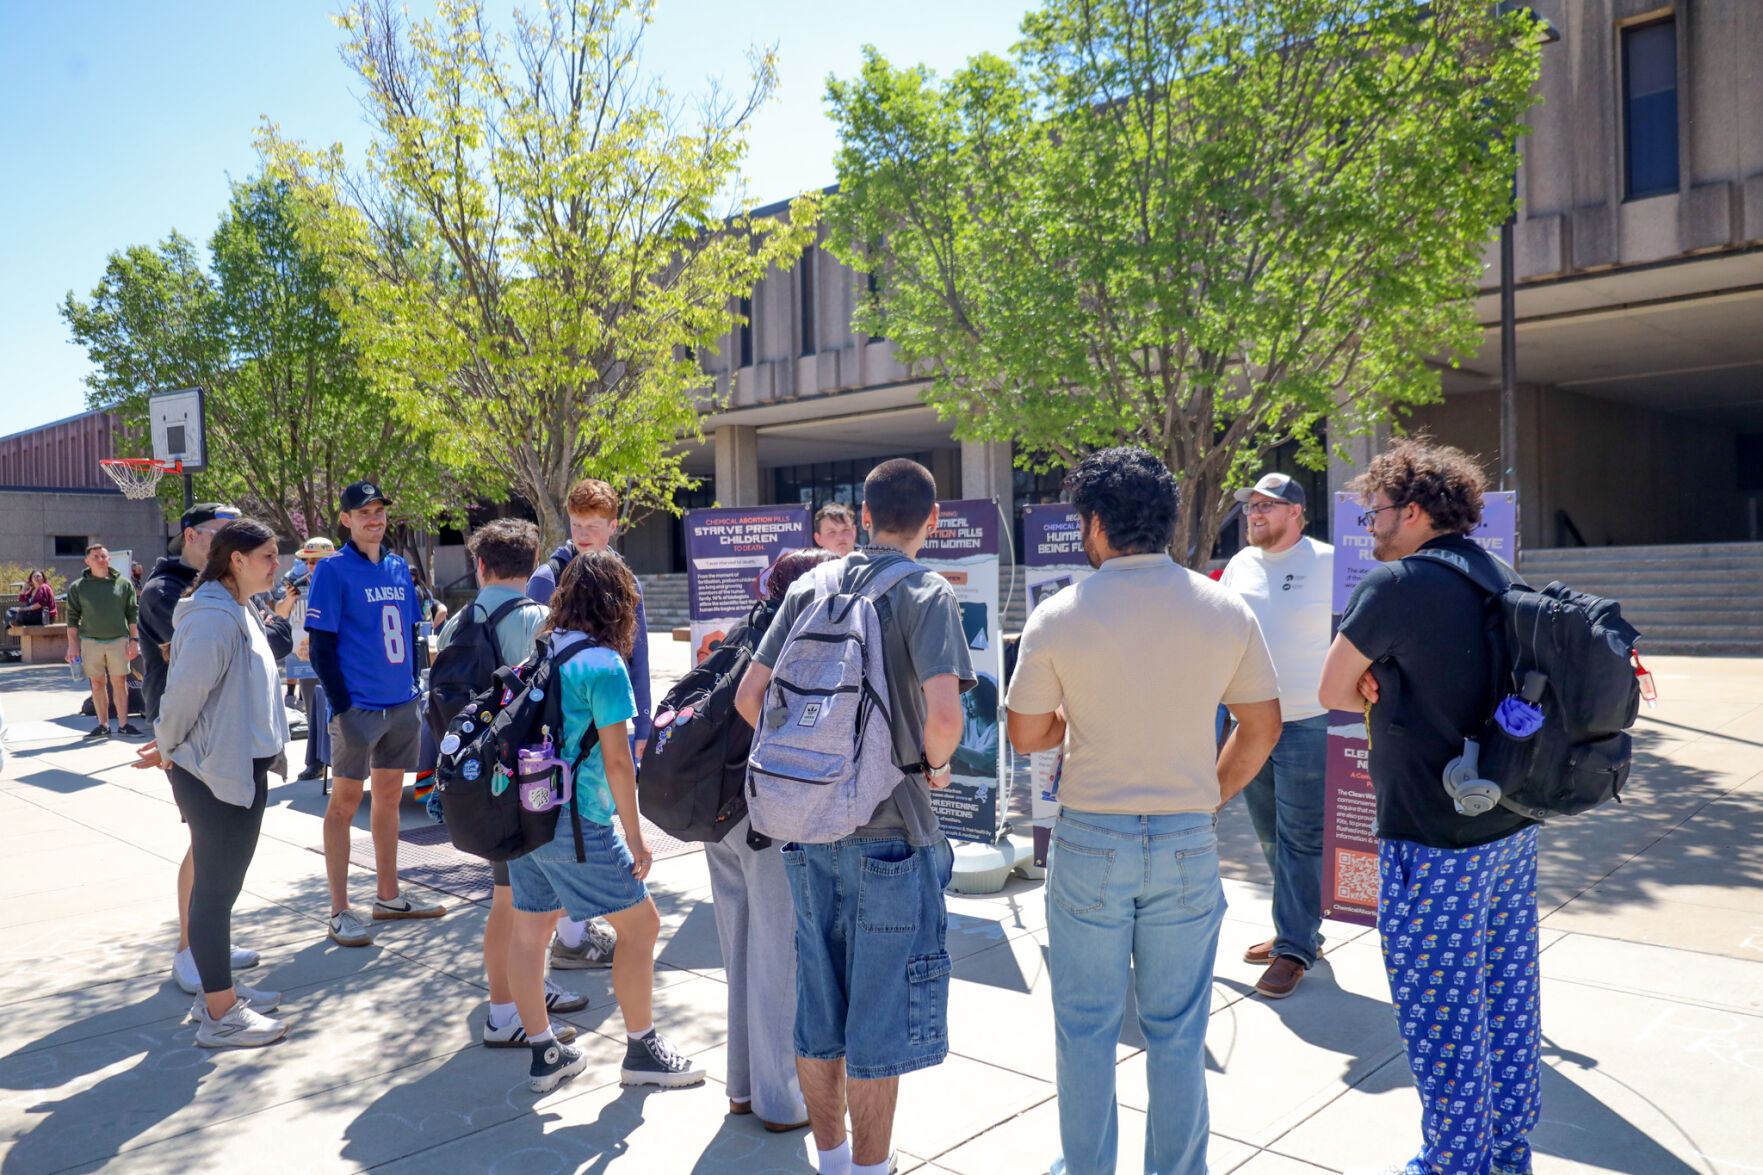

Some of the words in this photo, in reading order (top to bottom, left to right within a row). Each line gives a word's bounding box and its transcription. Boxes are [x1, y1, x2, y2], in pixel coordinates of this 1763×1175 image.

[739, 516, 773, 524] ABORTION
[773, 515, 790, 523] PILLS
[937, 518, 969, 527] EMICAL
[694, 525, 743, 536] STARVE
[745, 522, 802, 534] PREBORN
[957, 527, 983, 537] PILLS
[1043, 523, 1075, 531] CHEMICAL
[720, 533, 778, 545] CHILDREN
[1046, 531, 1083, 542] HUMA
[1342, 535, 1375, 547] MOT
[921, 540, 939, 549] RM
[940, 538, 980, 549] WOMEN
[1038, 543, 1070, 554] BEING
[364, 586, 405, 603] KANSAS
[382, 604, 406, 664] 8
[1347, 790, 1365, 798] Clean
